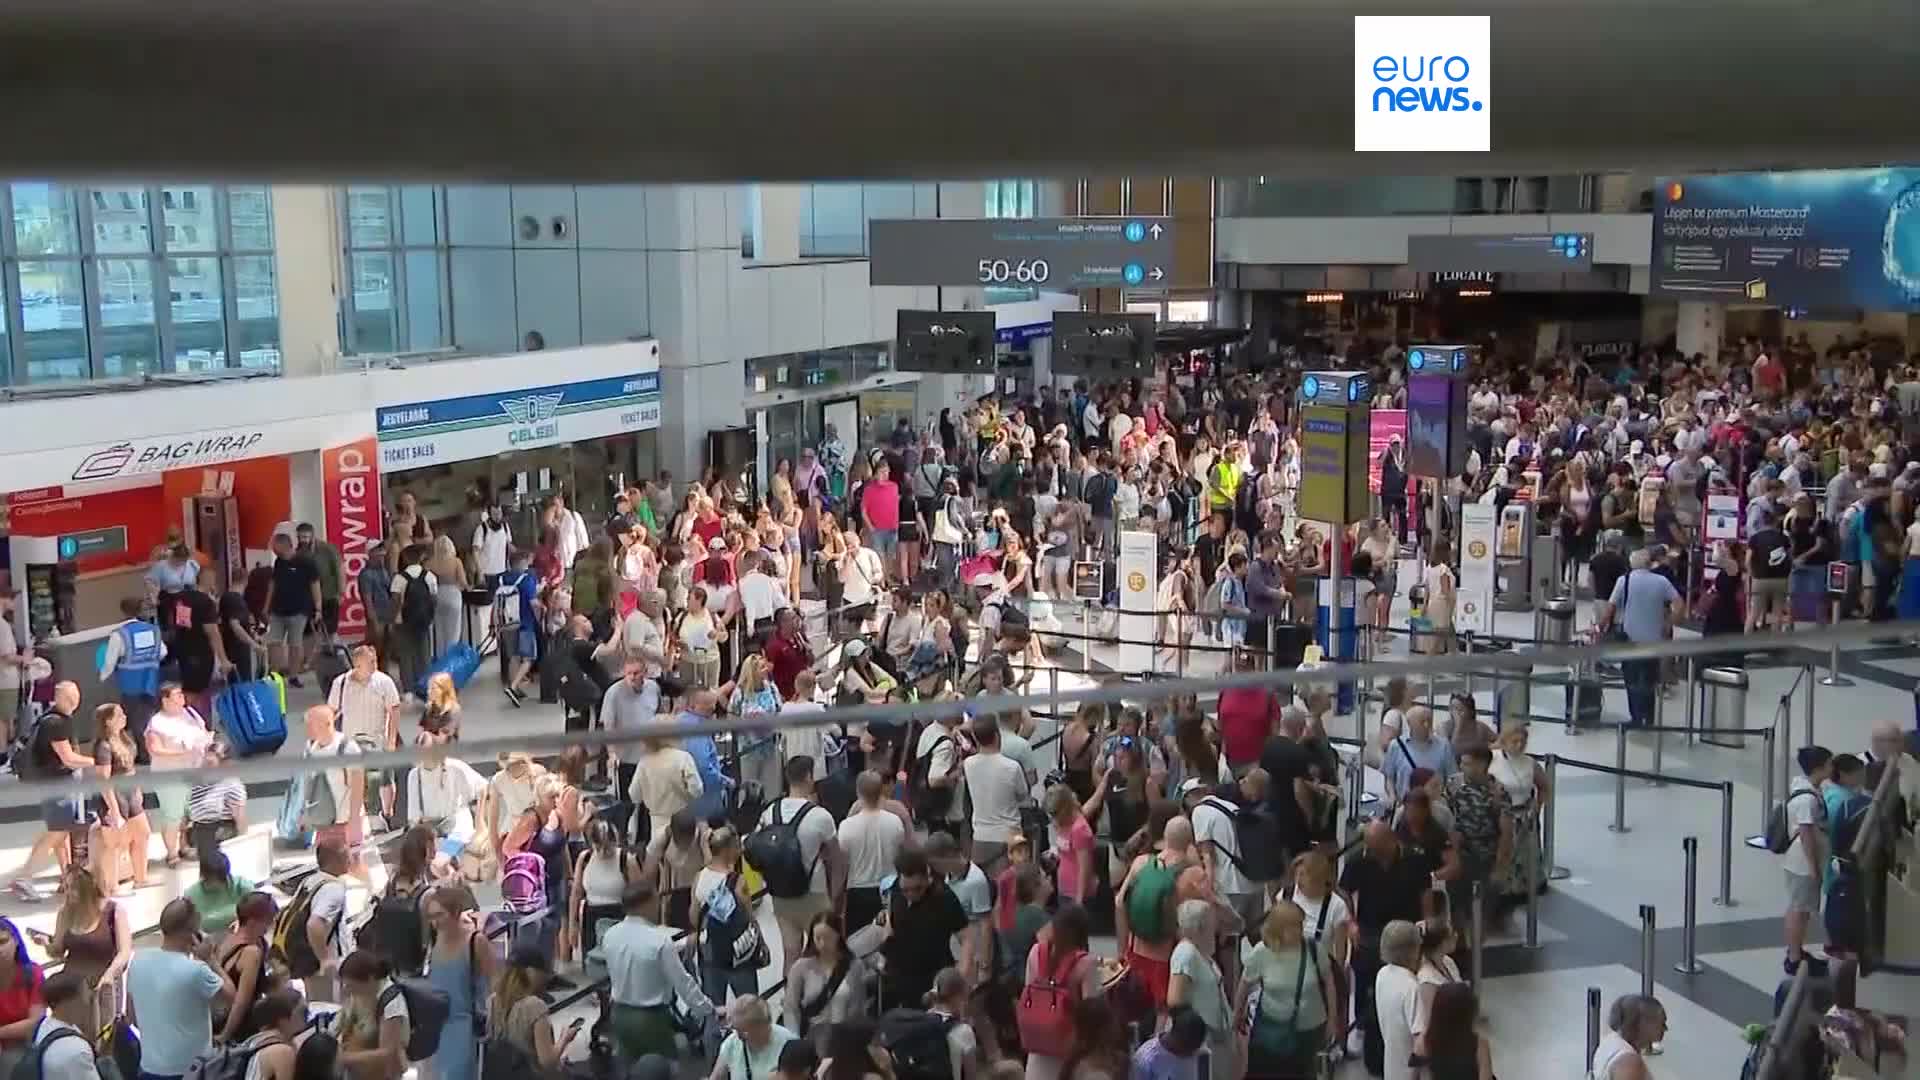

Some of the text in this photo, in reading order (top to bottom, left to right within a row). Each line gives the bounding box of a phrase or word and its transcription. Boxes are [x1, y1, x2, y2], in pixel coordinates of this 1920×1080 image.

[978, 258, 1049, 283] 50-60
[138, 442, 194, 463] BAG
[194, 433, 263, 454] WRAP
[384, 442, 435, 463] TICKET SALES
